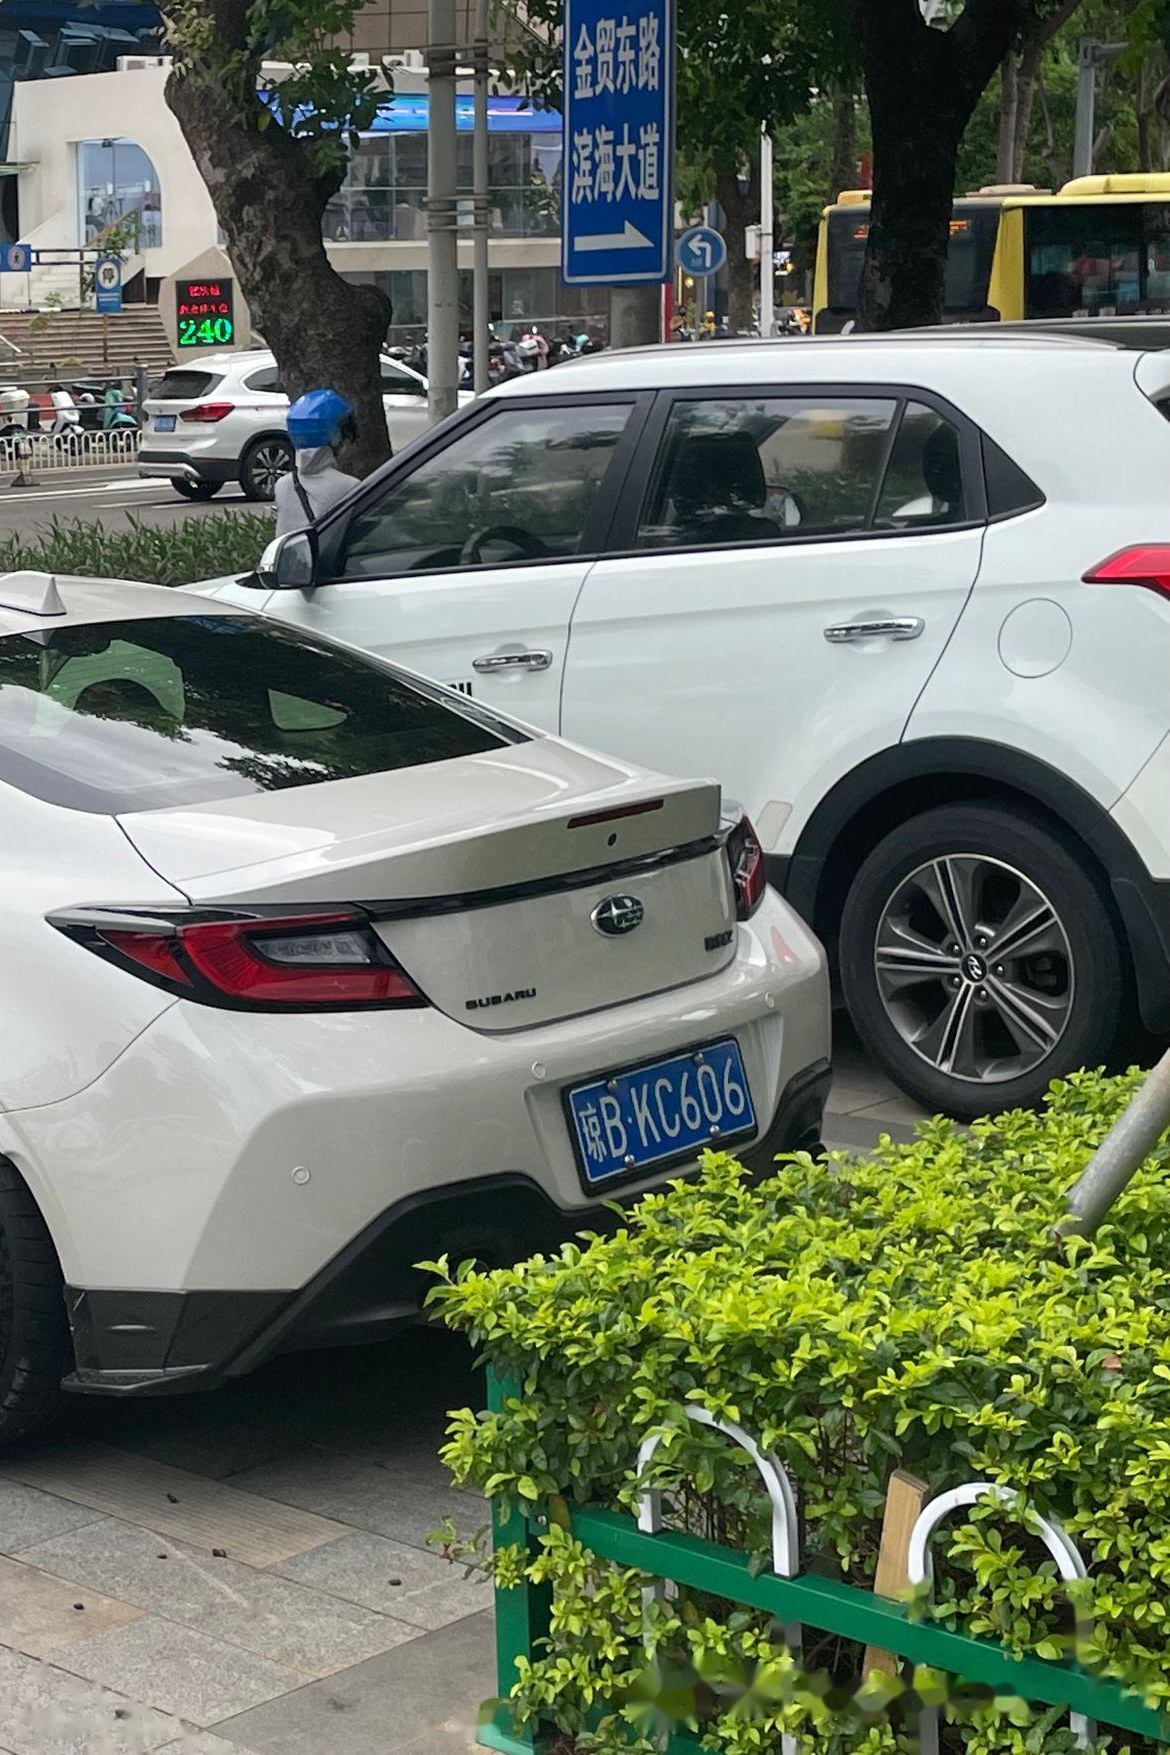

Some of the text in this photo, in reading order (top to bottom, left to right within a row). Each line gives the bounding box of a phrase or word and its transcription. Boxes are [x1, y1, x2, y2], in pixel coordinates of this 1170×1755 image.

[574, 11, 660, 99] 金贸东路
[572, 122, 660, 205] 滨海大道
[179, 318, 232, 345] 240
[465, 986, 537, 1010] SUBARU
